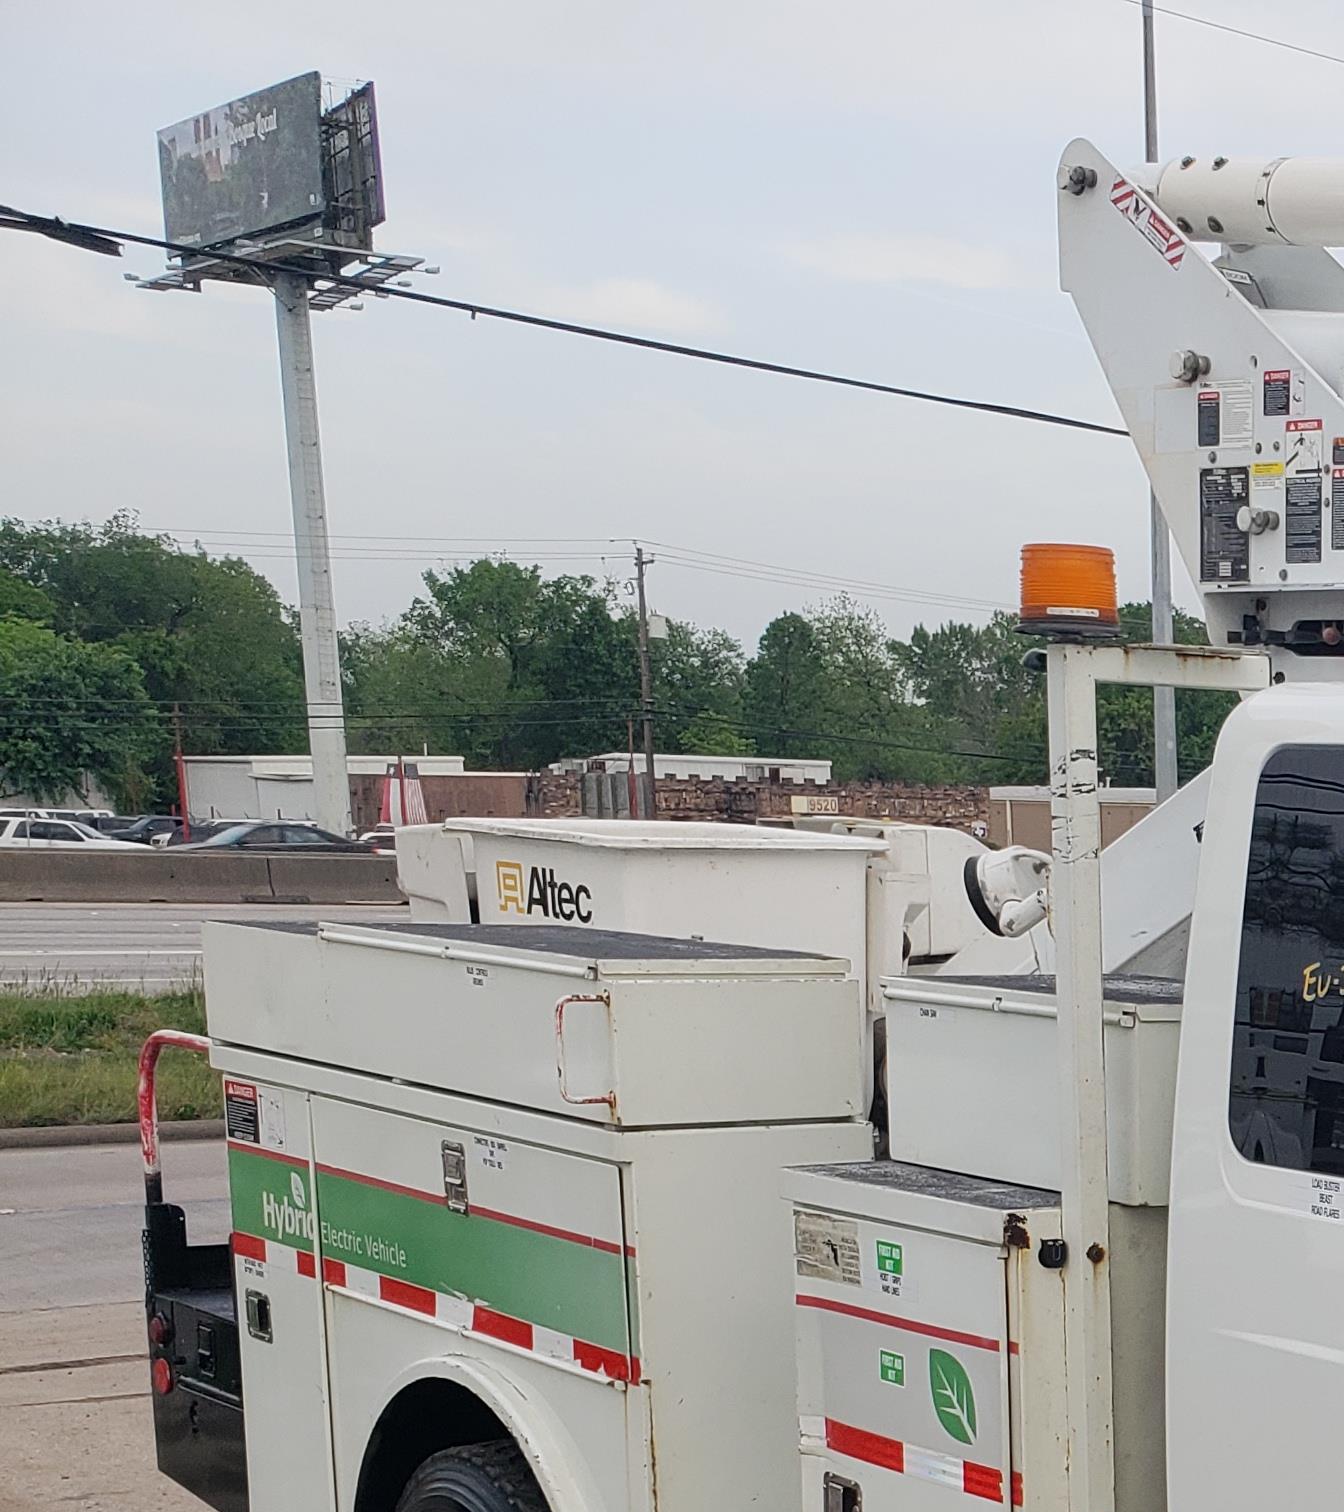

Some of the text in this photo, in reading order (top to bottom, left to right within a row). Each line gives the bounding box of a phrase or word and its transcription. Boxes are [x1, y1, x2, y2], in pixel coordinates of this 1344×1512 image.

[809, 798, 837, 812] 9520
[526, 865, 592, 924] Altec
[320, 1220, 363, 1255] Electric
[364, 1234, 408, 1268] Vehicle
